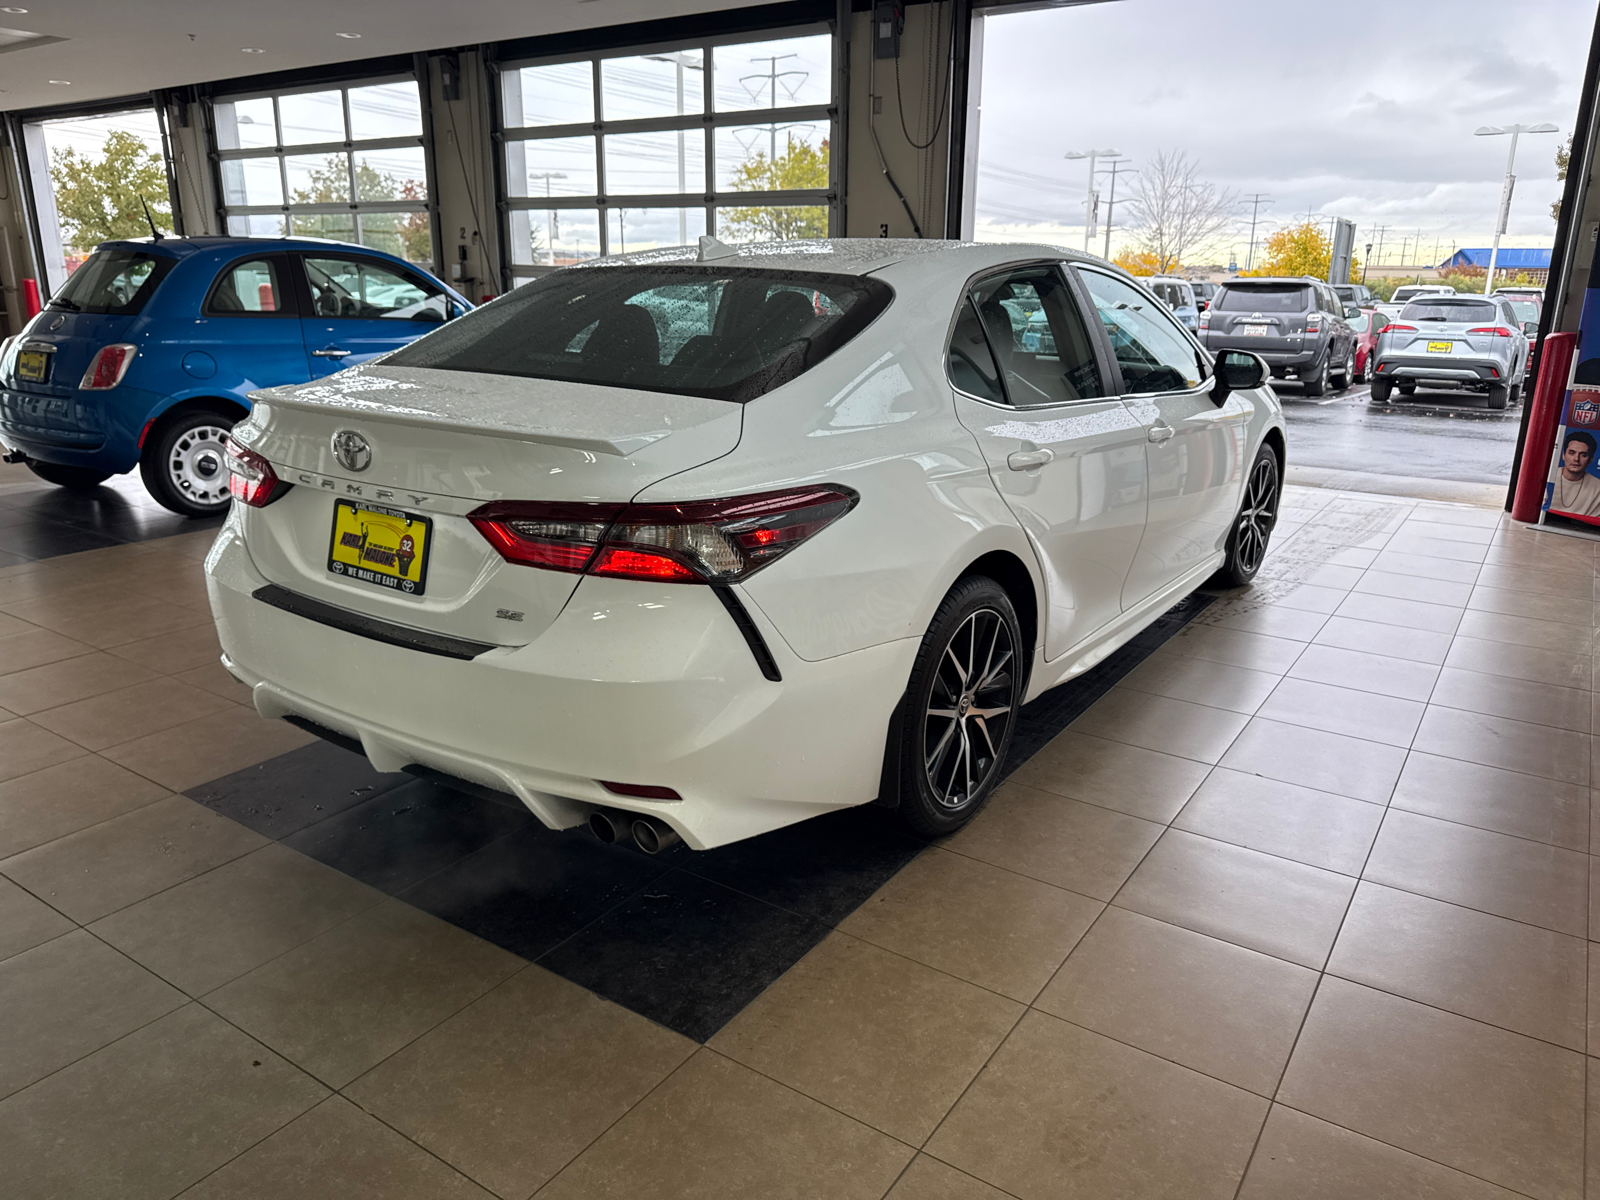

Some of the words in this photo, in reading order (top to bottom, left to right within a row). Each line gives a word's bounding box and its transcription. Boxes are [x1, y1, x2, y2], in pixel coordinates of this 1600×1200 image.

[460, 227, 466, 239] 2
[880, 224, 888, 238] 3
[1575, 411, 1594, 423] NFL
[299, 474, 428, 505] CAMRY
[355, 502, 368, 511] KARL
[368, 504, 388, 515] MALONE
[388, 509, 406, 519] TOYOTA
[340, 531, 363, 550] KARL
[402, 540, 411, 551] 32
[363, 546, 397, 568] MALONE
[348, 566, 357, 577] WE
[358, 569, 374, 581] MAKE
[375, 574, 382, 583] IT
[382, 576, 398, 587] EASY
[495, 608, 525, 622] SE
